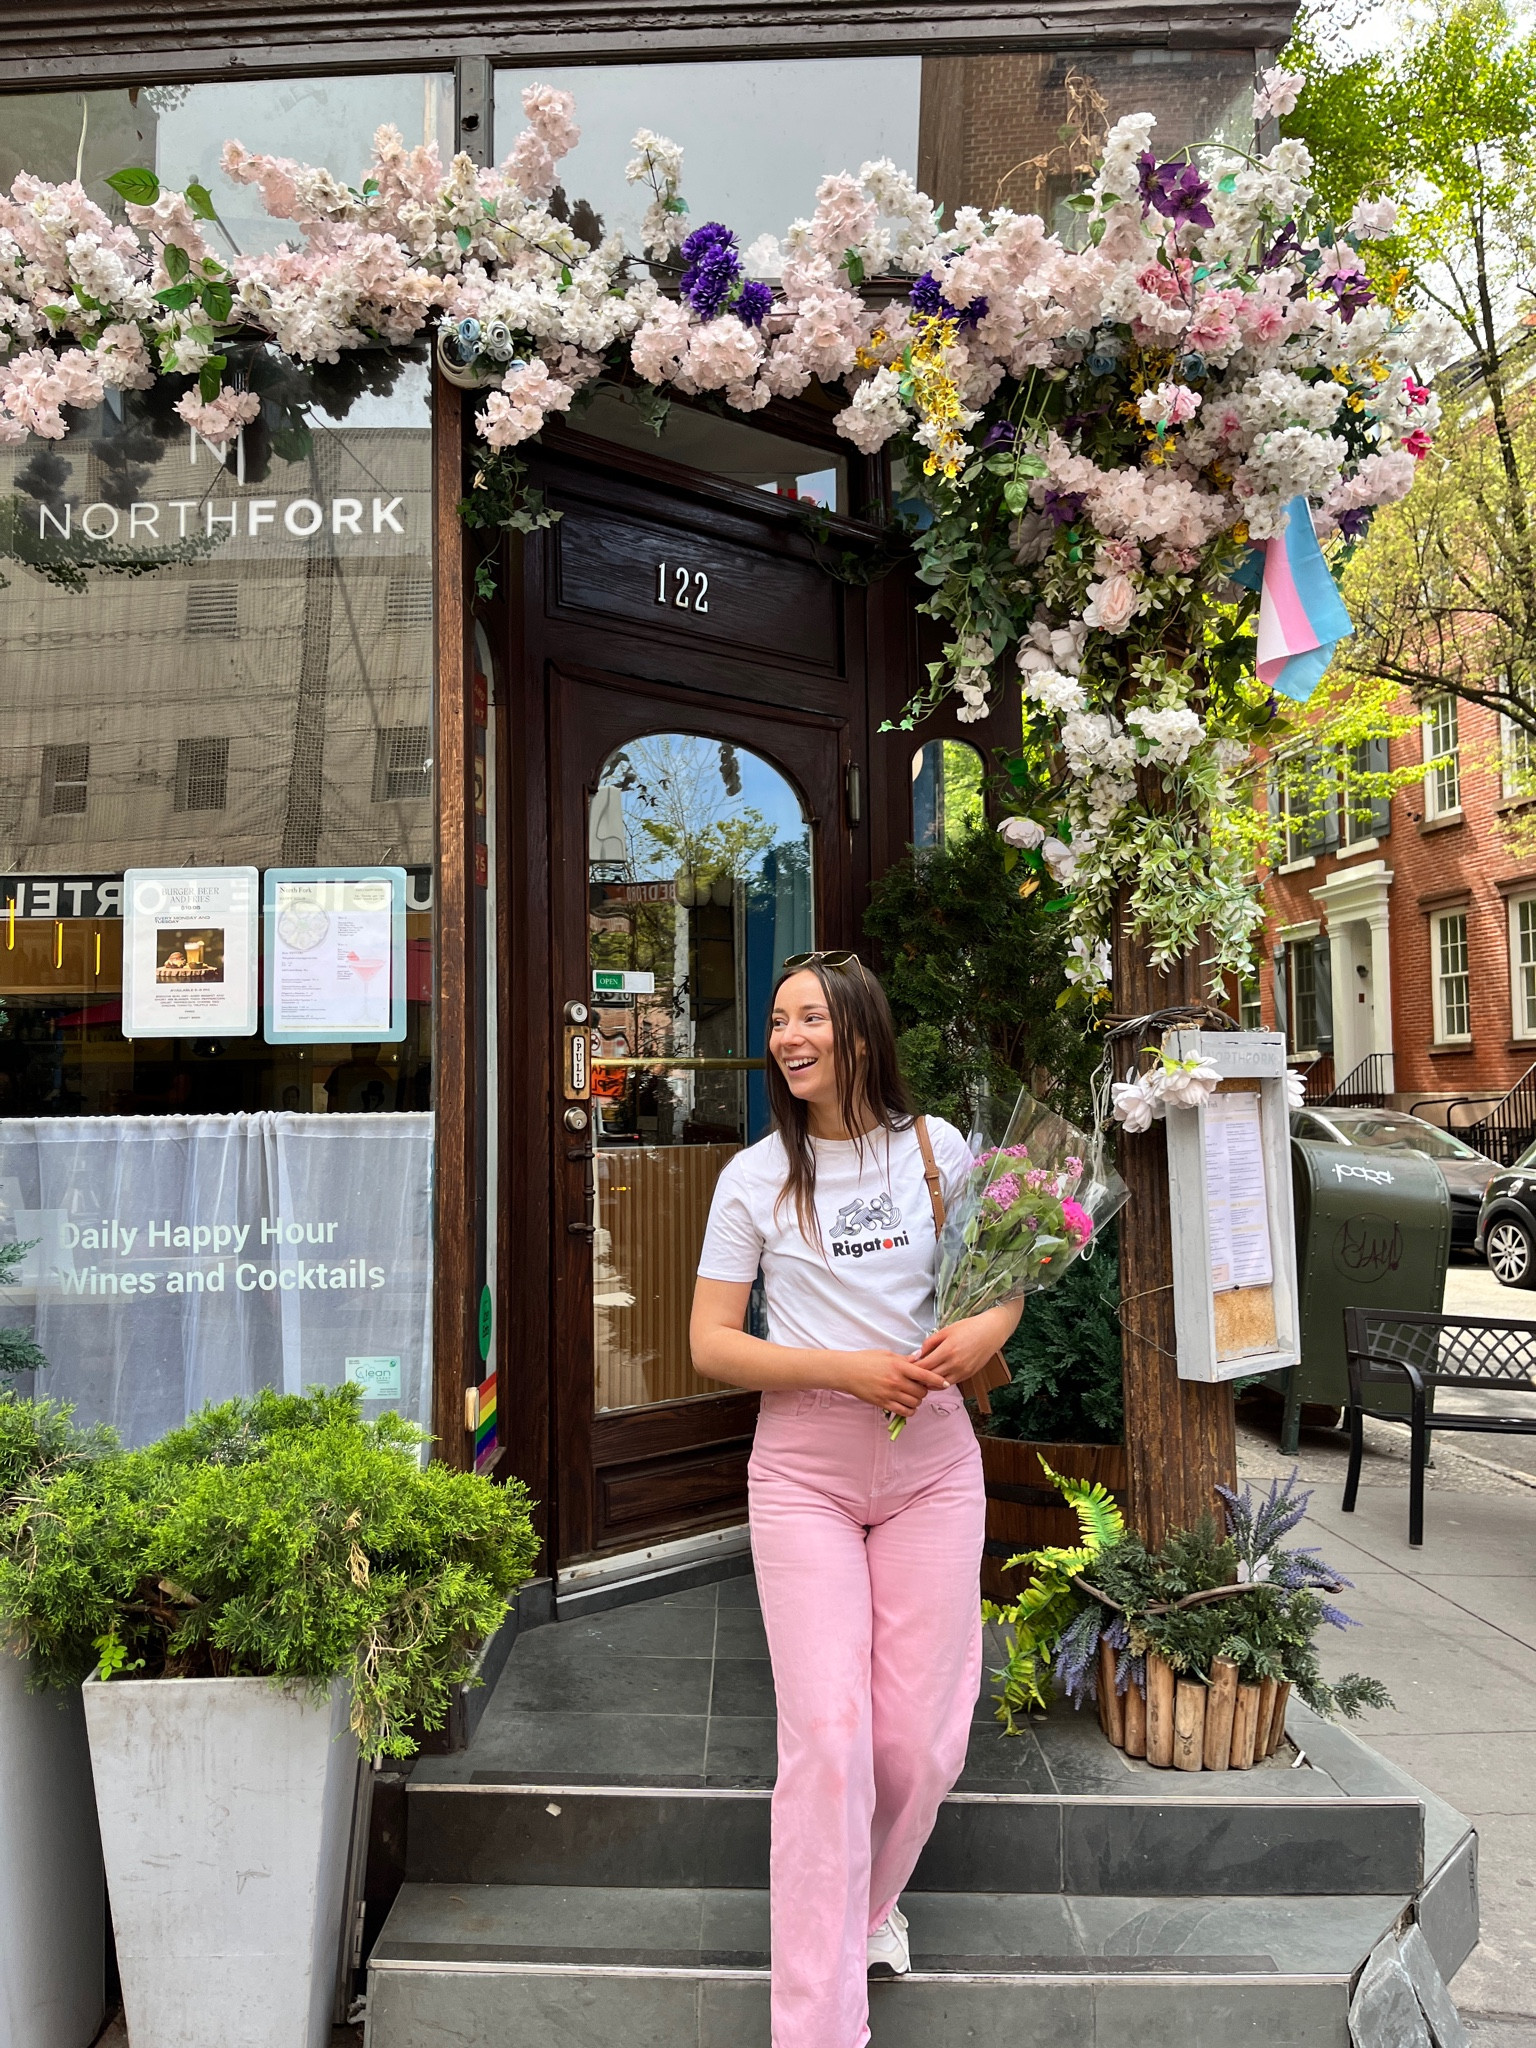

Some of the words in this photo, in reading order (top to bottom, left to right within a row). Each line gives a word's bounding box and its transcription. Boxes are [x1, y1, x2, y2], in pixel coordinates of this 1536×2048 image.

[39, 497, 405, 540] NORTHFORK
[658, 562, 709, 613] 122
[198, 887, 220, 895] BEER
[600, 977, 619, 986] OPEN
[59, 1219, 138, 1256] Daily
[148, 1219, 250, 1254] Happy
[260, 1217, 339, 1245] Hour
[832, 1230, 909, 1258] Rigatoni
[59, 1265, 156, 1295] Wines
[166, 1262, 225, 1292] and
[235, 1259, 386, 1291] Cocktails
[355, 1366, 391, 1379] Clean
